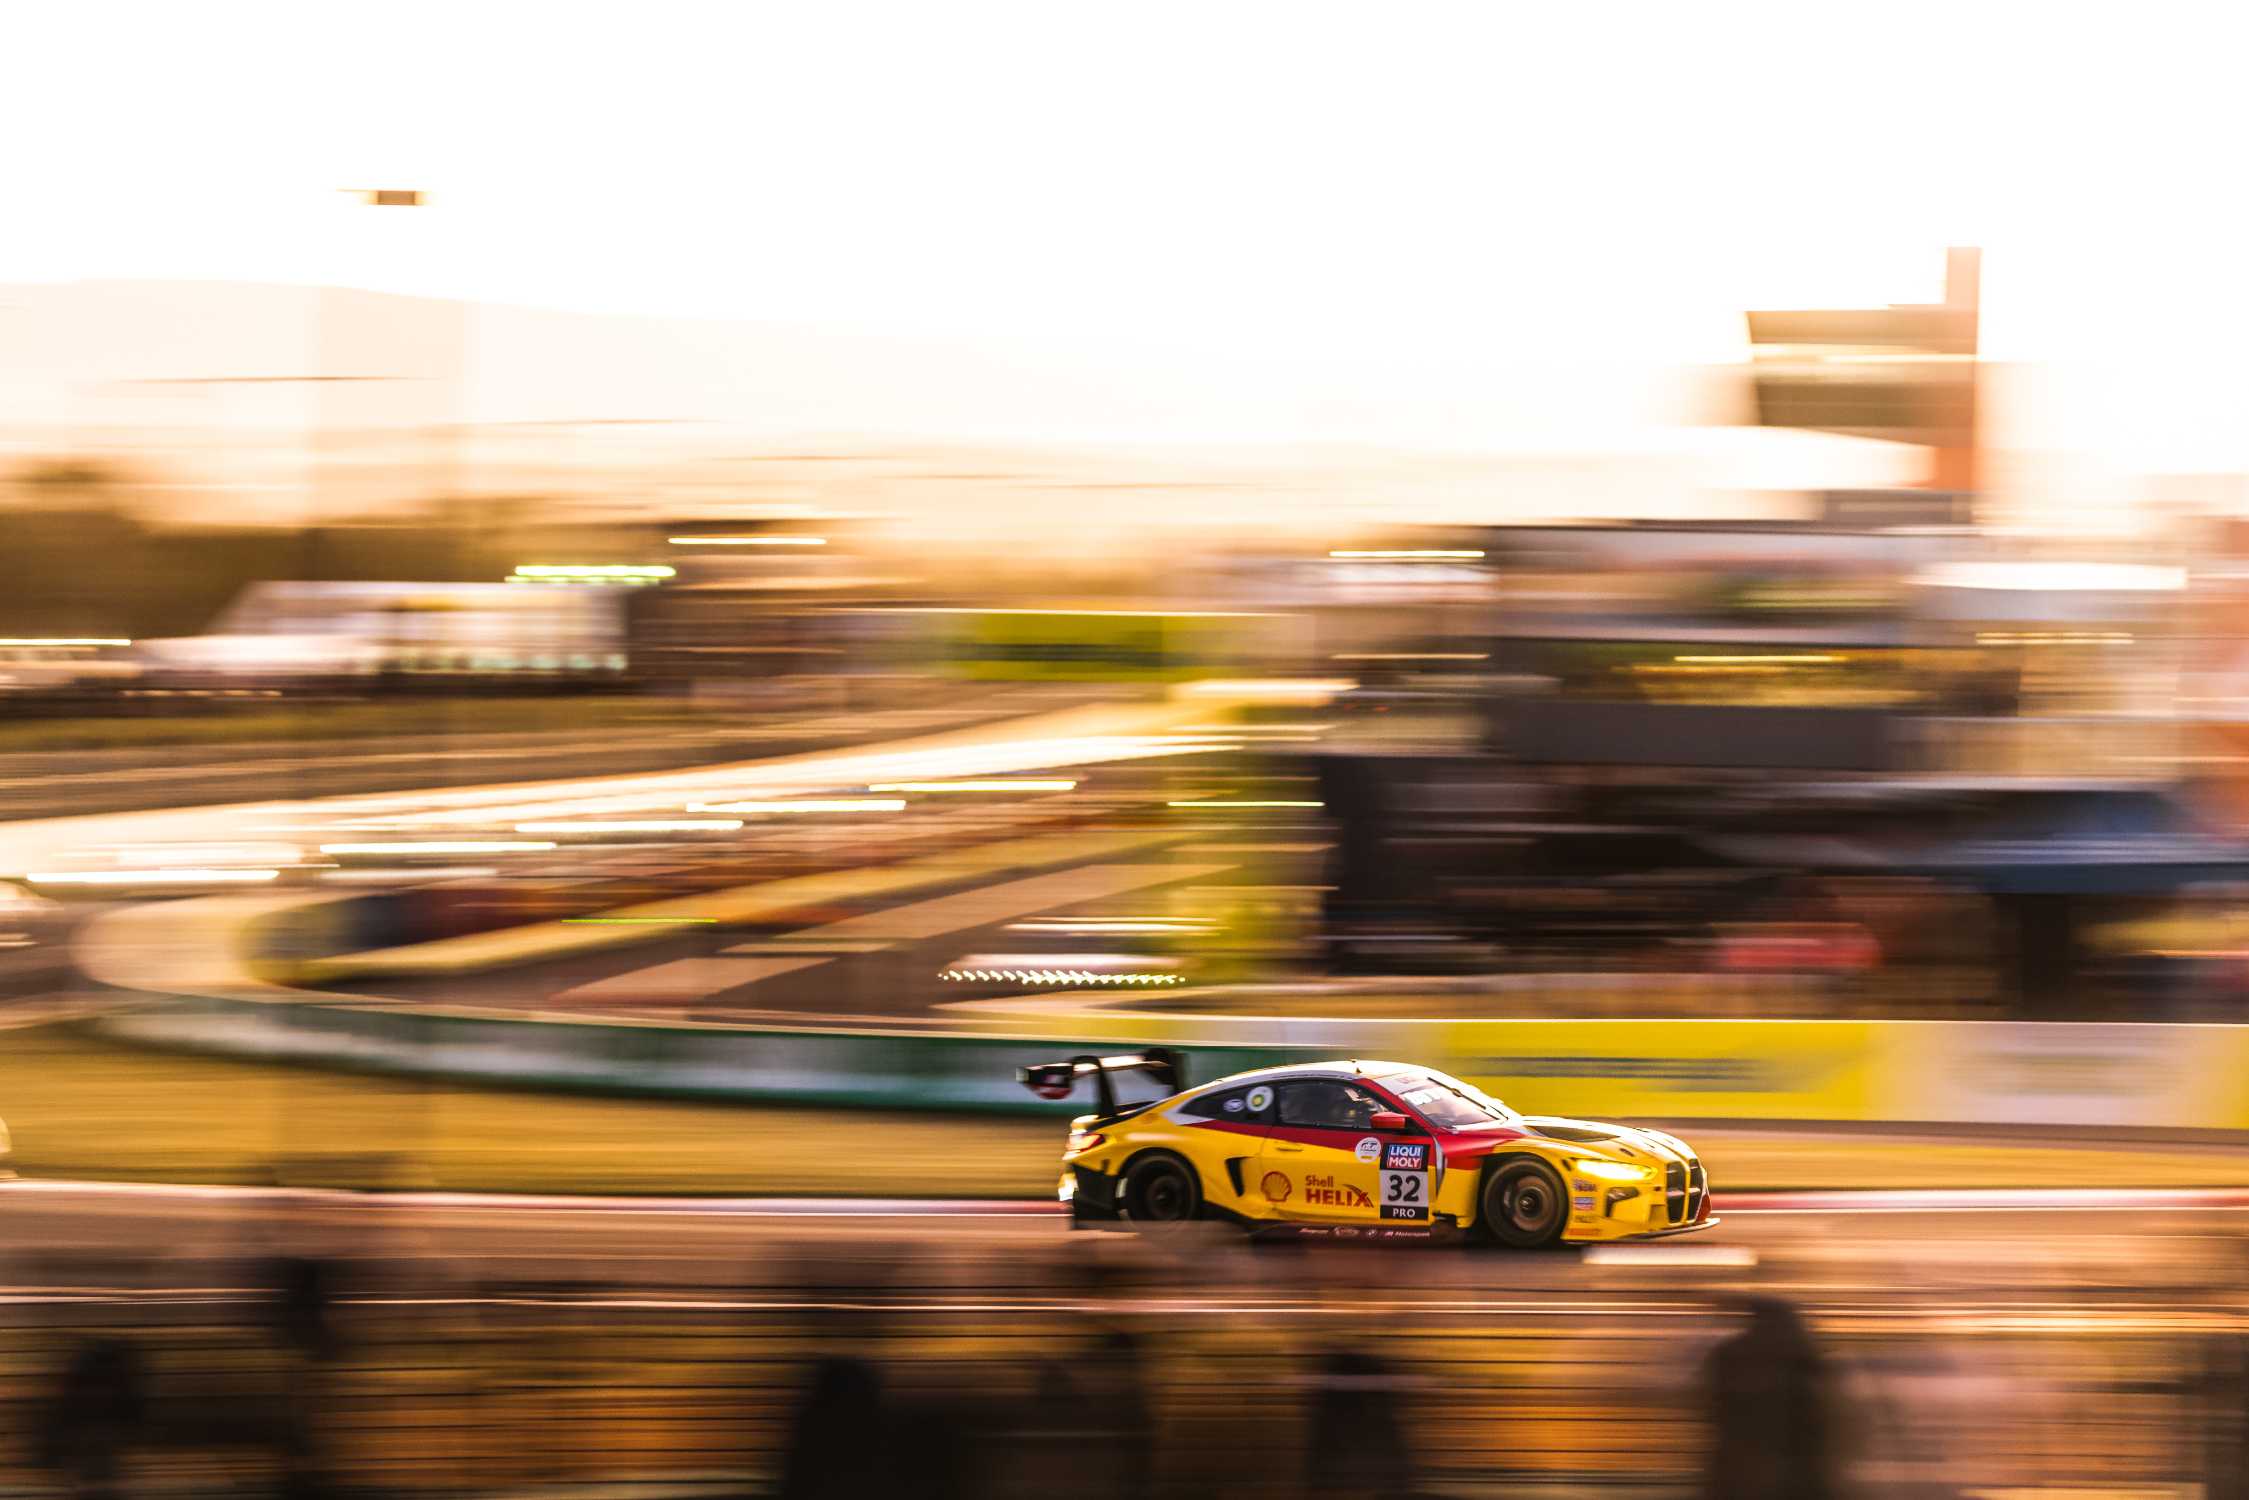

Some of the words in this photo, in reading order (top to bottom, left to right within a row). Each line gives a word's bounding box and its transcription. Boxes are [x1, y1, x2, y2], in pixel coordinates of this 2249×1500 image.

[1390, 1145, 1421, 1157] LIQUI
[1388, 1157, 1421, 1168] MOLY
[1305, 1175, 1334, 1187] Shell
[1387, 1174, 1420, 1202] 32
[1305, 1186, 1374, 1208] HELIX
[1392, 1208, 1416, 1217] PRO
